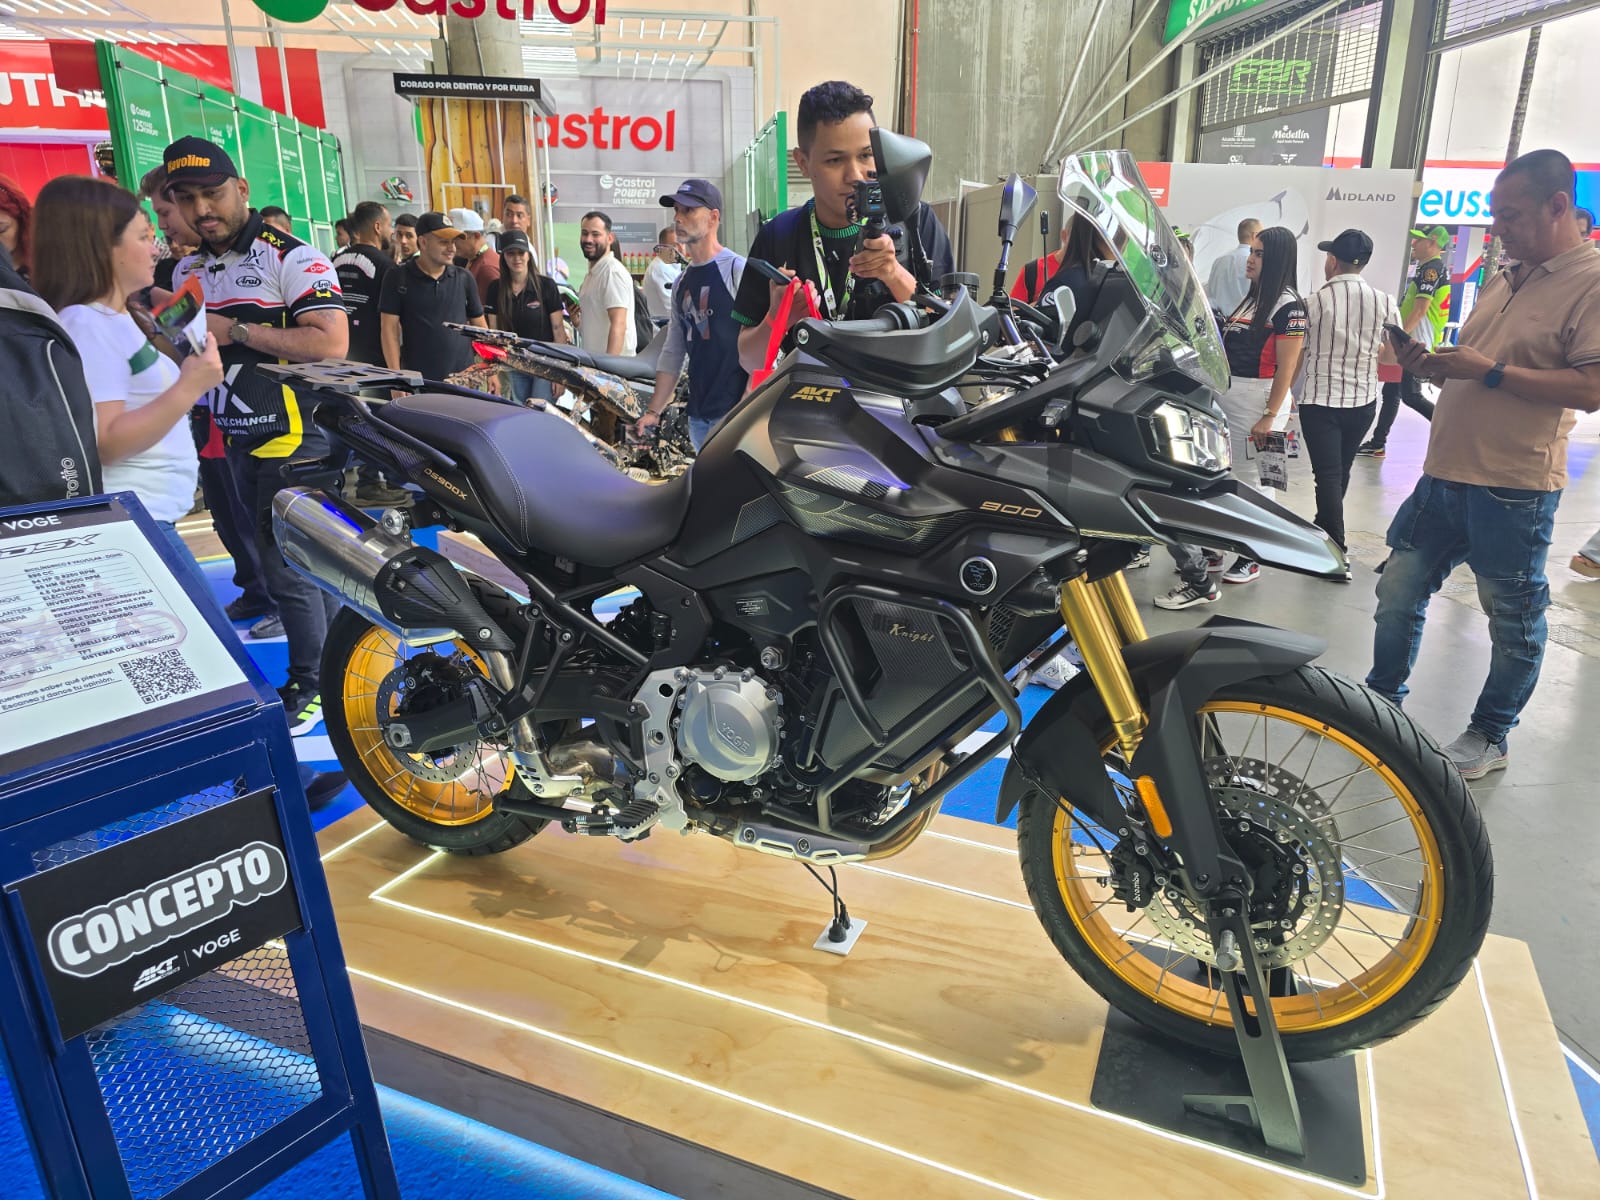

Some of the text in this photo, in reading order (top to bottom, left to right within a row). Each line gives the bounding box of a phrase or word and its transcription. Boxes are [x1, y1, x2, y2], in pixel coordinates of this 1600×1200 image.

[400, 81, 434, 89] DORADO
[453, 83, 484, 91] DENTRO
[509, 84, 535, 92] FUERA
[533, 106, 675, 152] astrol
[615, 177, 656, 188] Castrol
[1326, 187, 1396, 202] MIDLAND
[790, 386, 842, 402] AKT
[980, 501, 1043, 518] 900
[3, 515, 62, 531] VOGE
[46, 596, 87, 607] INVERTIDA
[58, 616, 84, 625] DOBLE
[84, 611, 107, 619] DISCO
[61, 621, 86, 631] DISCO
[889, 623, 936, 642] Knight
[73, 639, 102, 649] PIRELLI
[81, 648, 115, 660] SISTEMA
[126, 634, 175, 650] CALEFACCIÓN
[39, 682, 63, 692] saber
[64, 677, 80, 687] qué
[1, 697, 40, 710] Escanea
[59, 848, 271, 966] CONCEPTO
[192, 929, 241, 959] VOGE
